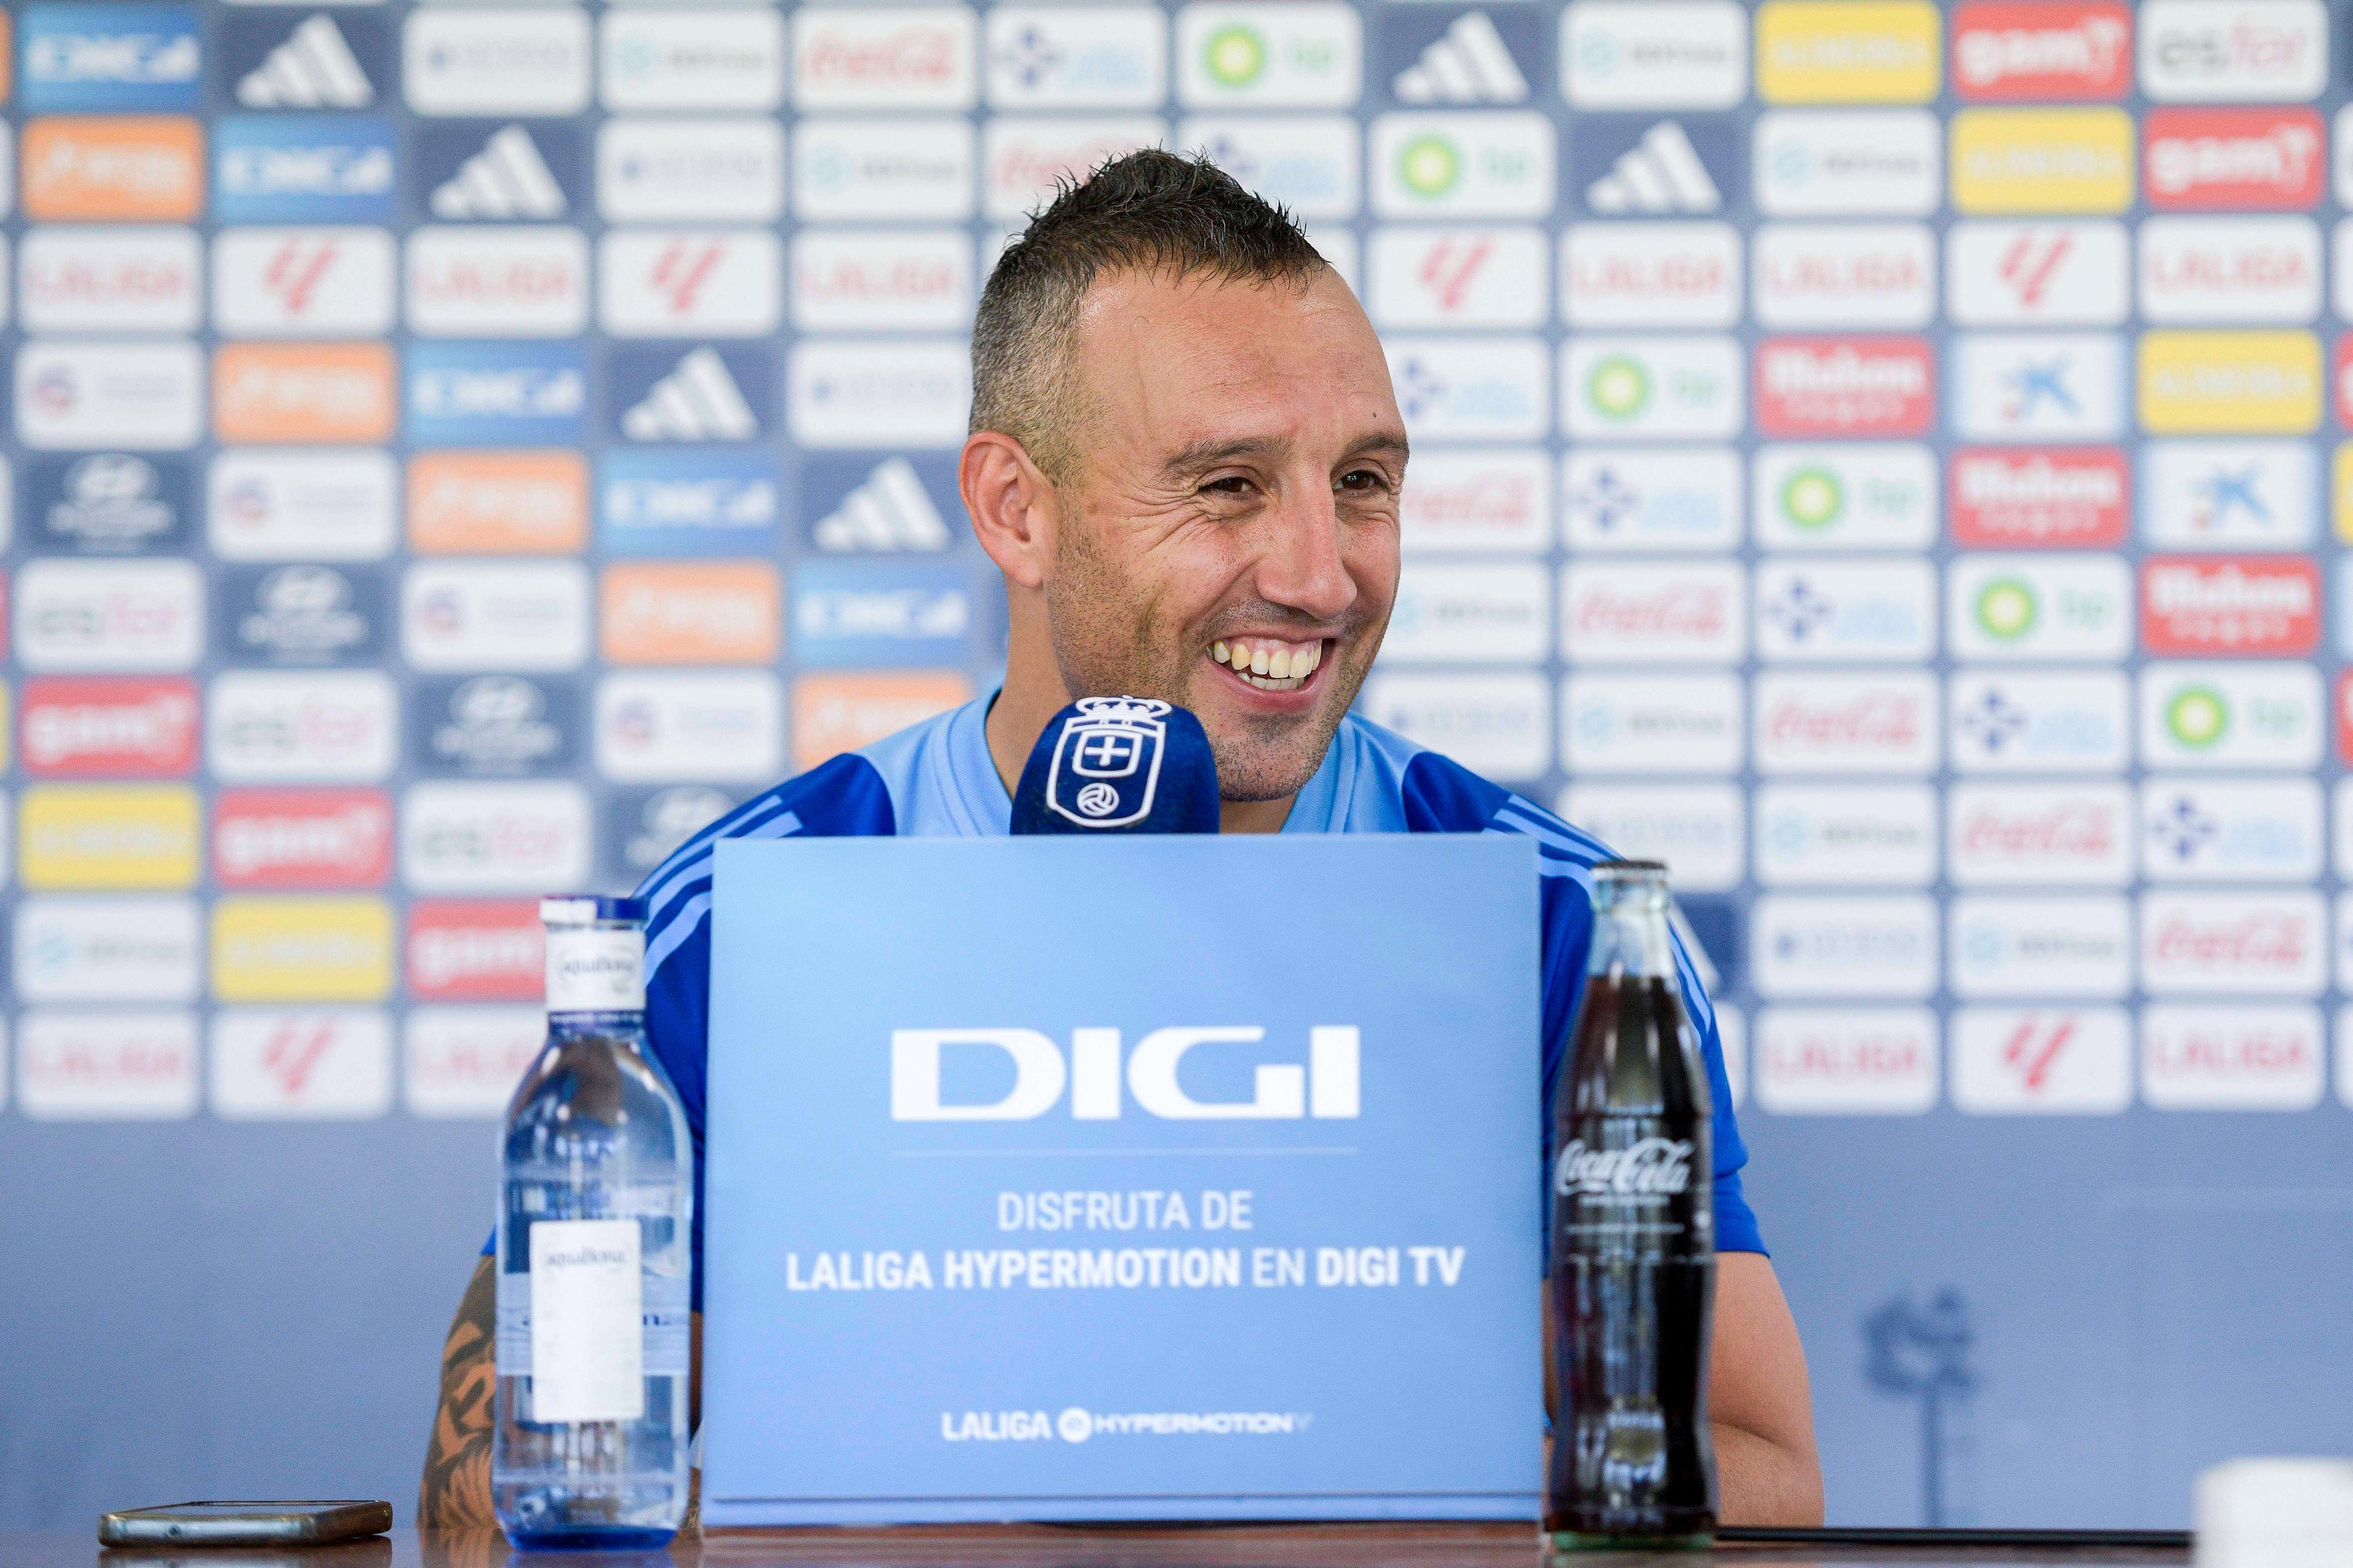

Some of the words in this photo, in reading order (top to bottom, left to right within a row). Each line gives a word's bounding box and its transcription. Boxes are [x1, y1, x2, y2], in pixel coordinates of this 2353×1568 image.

[891, 1026, 1360, 1121] DIGI
[998, 1190, 1191, 1231] DISFRUTA
[1201, 1190, 1253, 1230] DE
[787, 1251, 933, 1291] LALIGA
[945, 1248, 1240, 1289] HYPERMOTION
[1252, 1247, 1305, 1287] EN
[1318, 1247, 1399, 1286] DIGI
[1406, 1246, 1465, 1286] TV
[941, 1410, 1052, 1441] LALIGA
